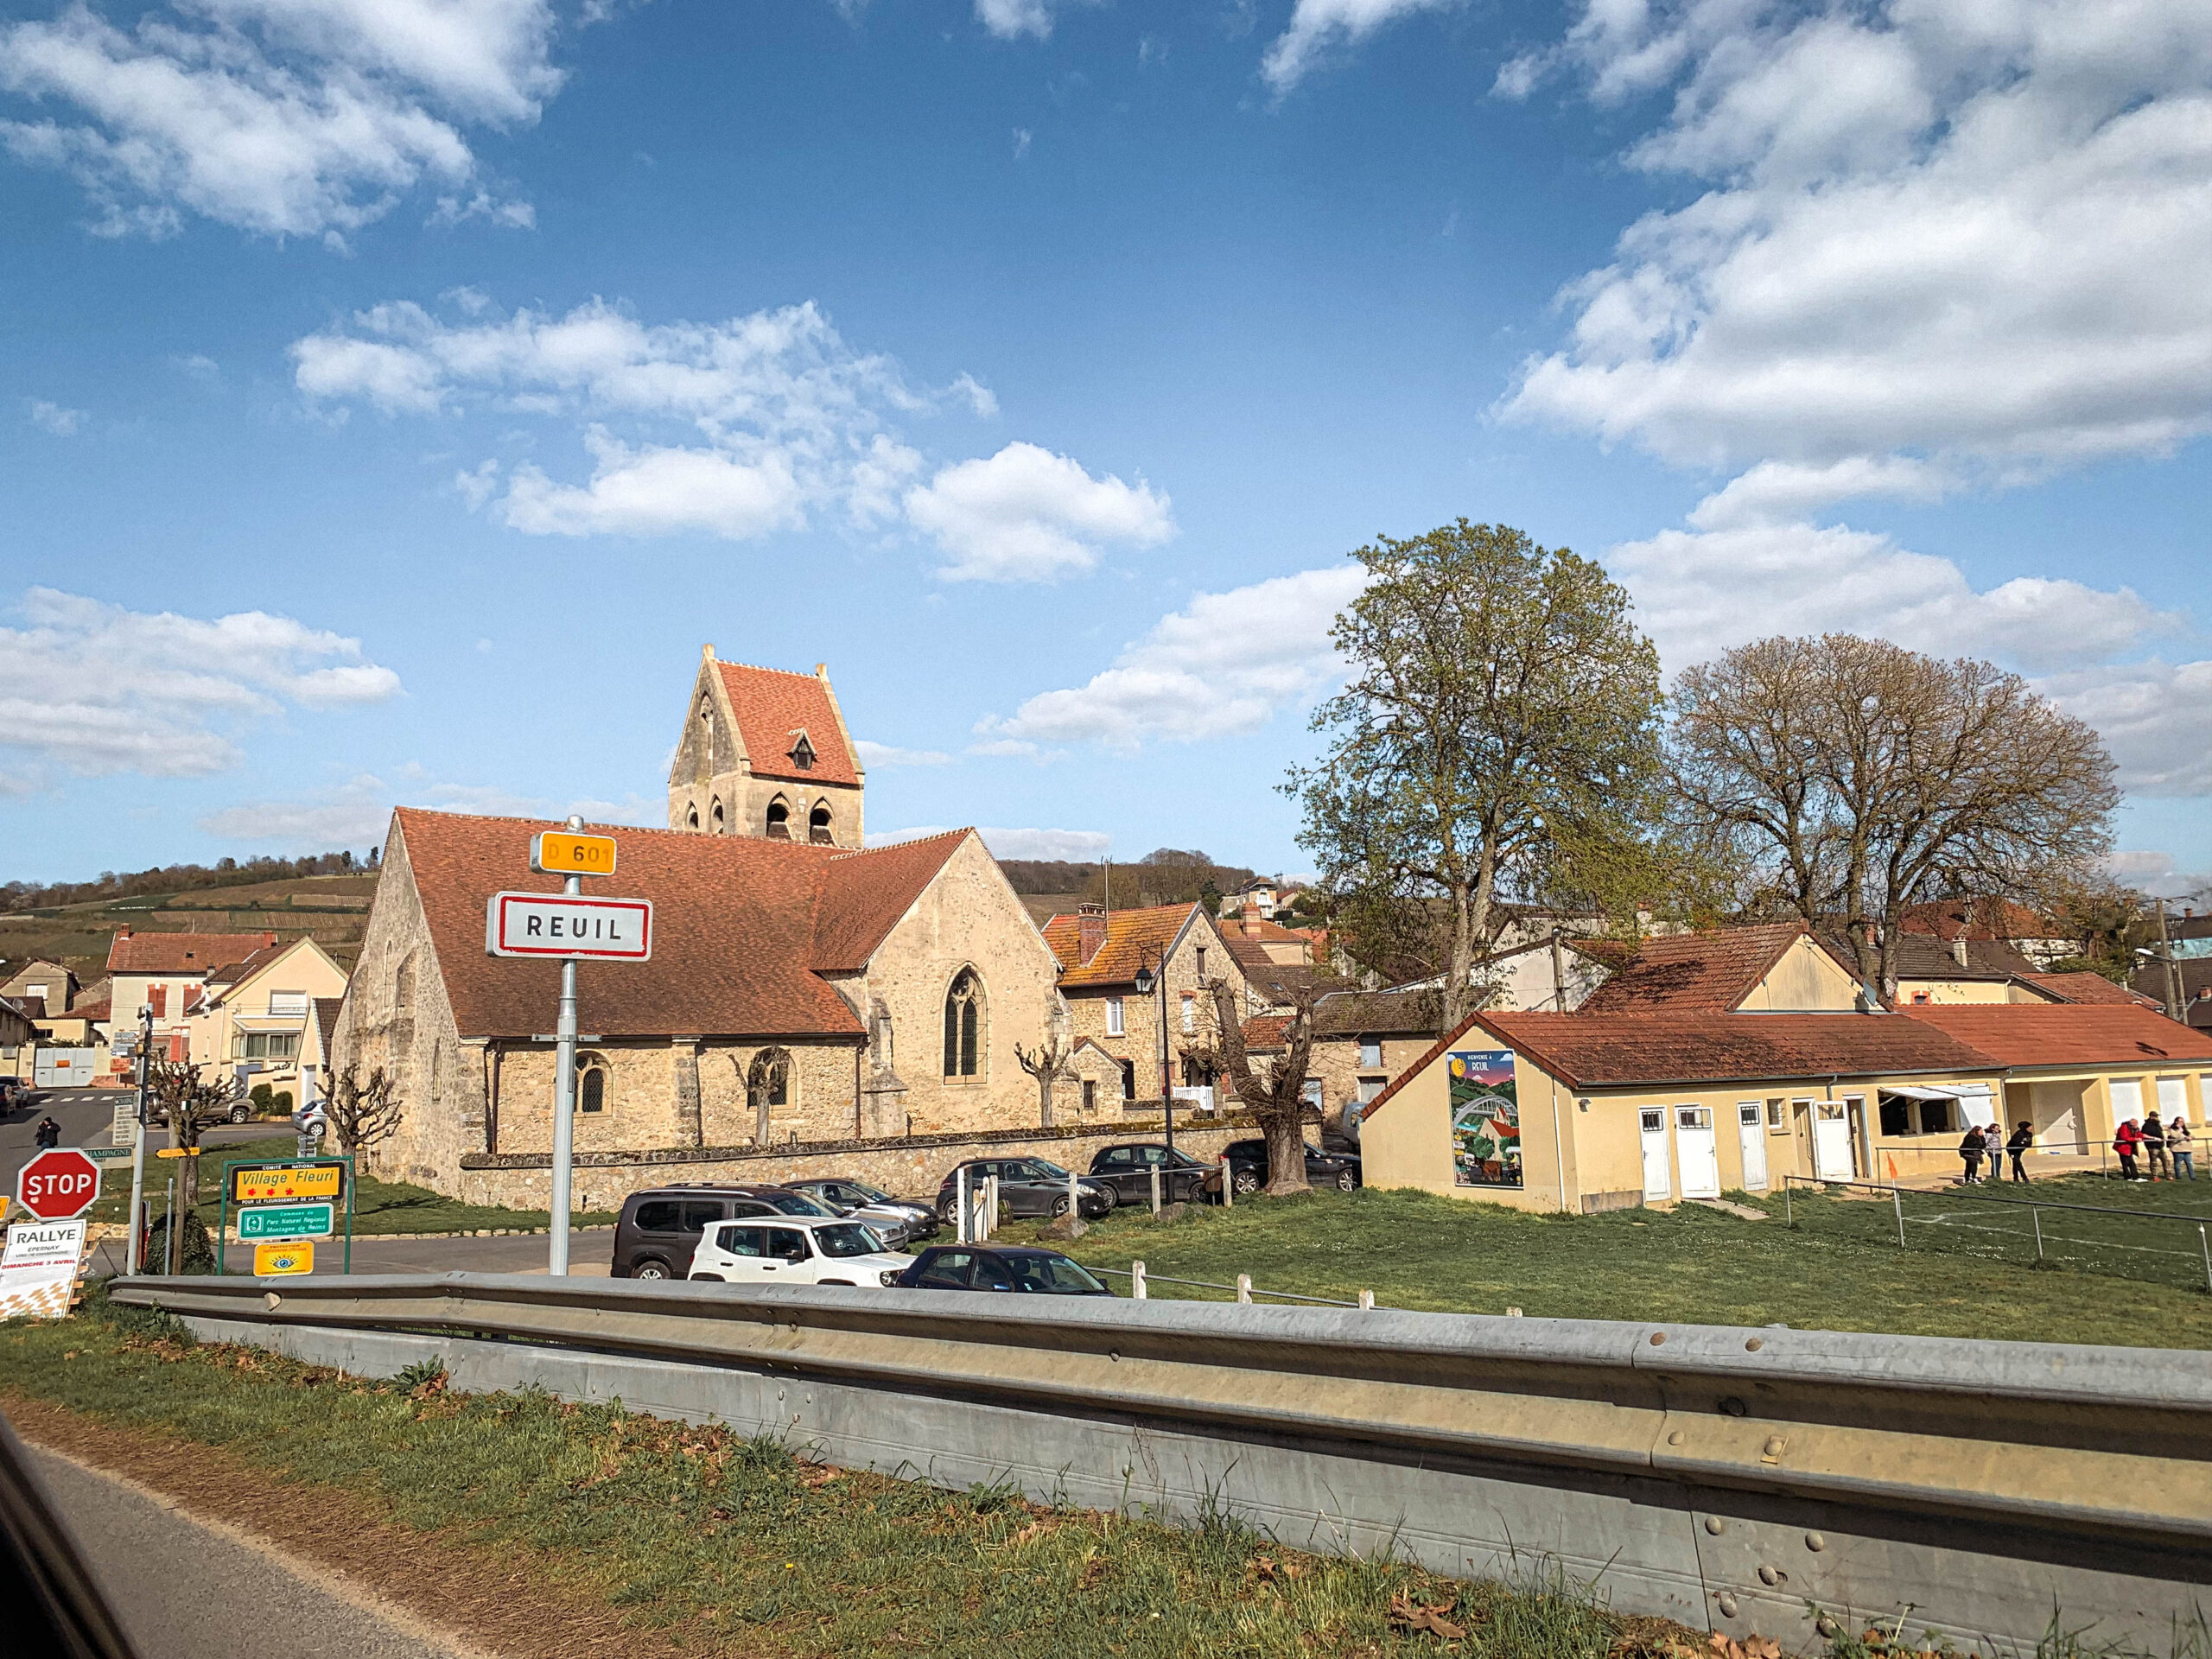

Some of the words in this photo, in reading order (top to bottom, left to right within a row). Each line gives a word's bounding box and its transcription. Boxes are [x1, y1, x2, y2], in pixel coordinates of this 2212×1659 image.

[547, 842, 560, 860] D
[573, 845, 610, 864] 601
[526, 914, 621, 940] REUIL
[1471, 1061, 1490, 1071] REUIL
[27, 1173, 92, 1196] STOP
[242, 1172, 288, 1186] Village
[296, 1169, 334, 1183] Fleuri
[16, 1229, 76, 1244] RALLYE
[1, 1261, 44, 1269] DIMANCHE
